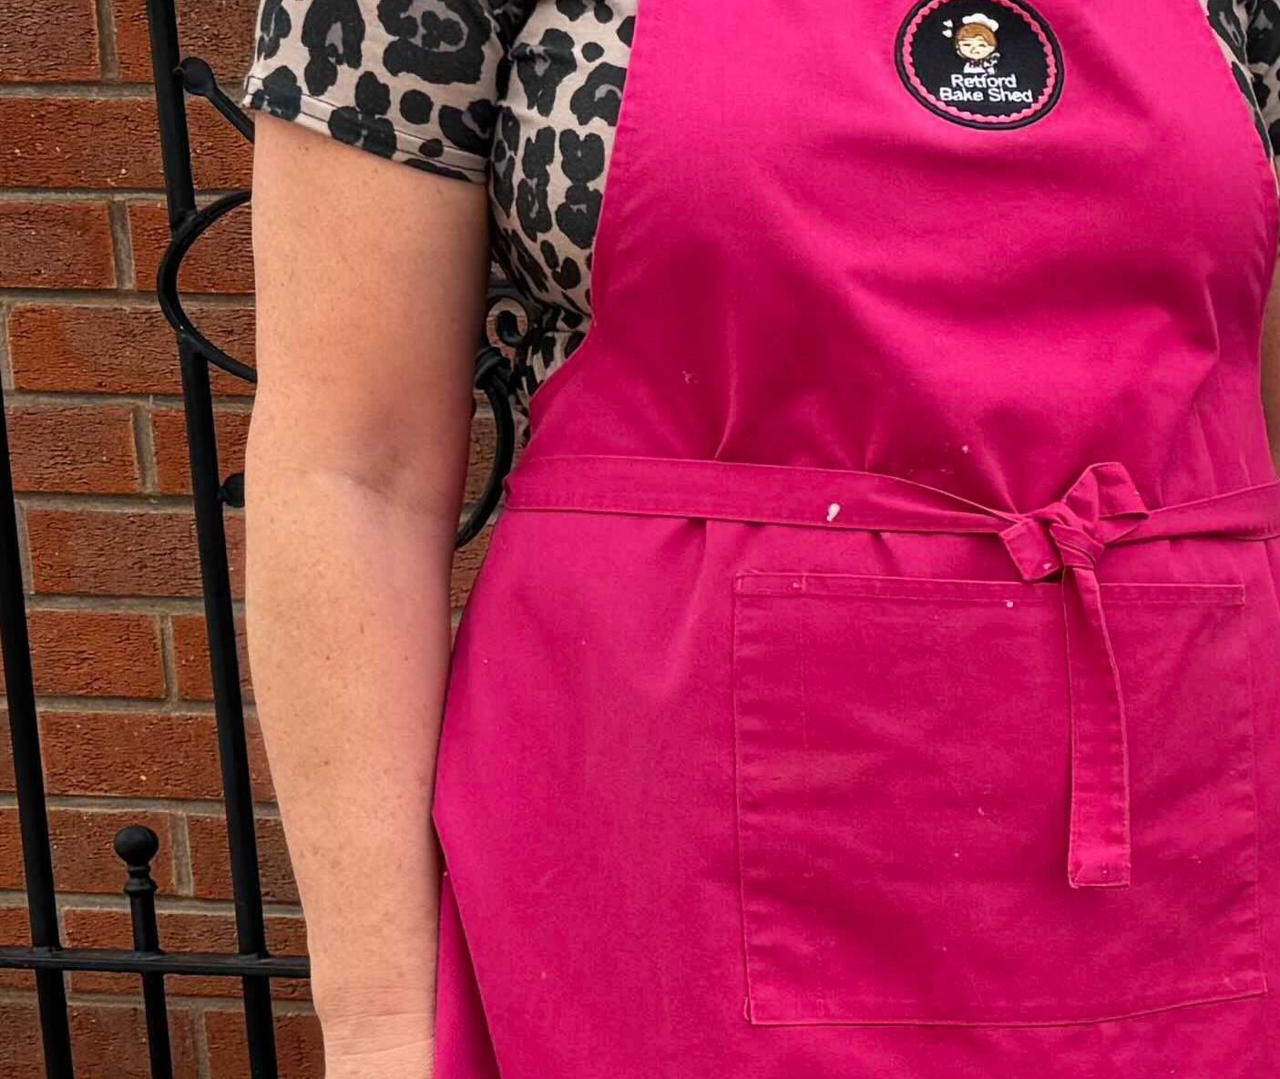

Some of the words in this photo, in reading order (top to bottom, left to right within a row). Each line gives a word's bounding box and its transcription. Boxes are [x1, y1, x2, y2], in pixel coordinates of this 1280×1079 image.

[950, 74, 1017, 88] Retford
[939, 87, 984, 102] Bake
[988, 88, 1033, 103] Shed
